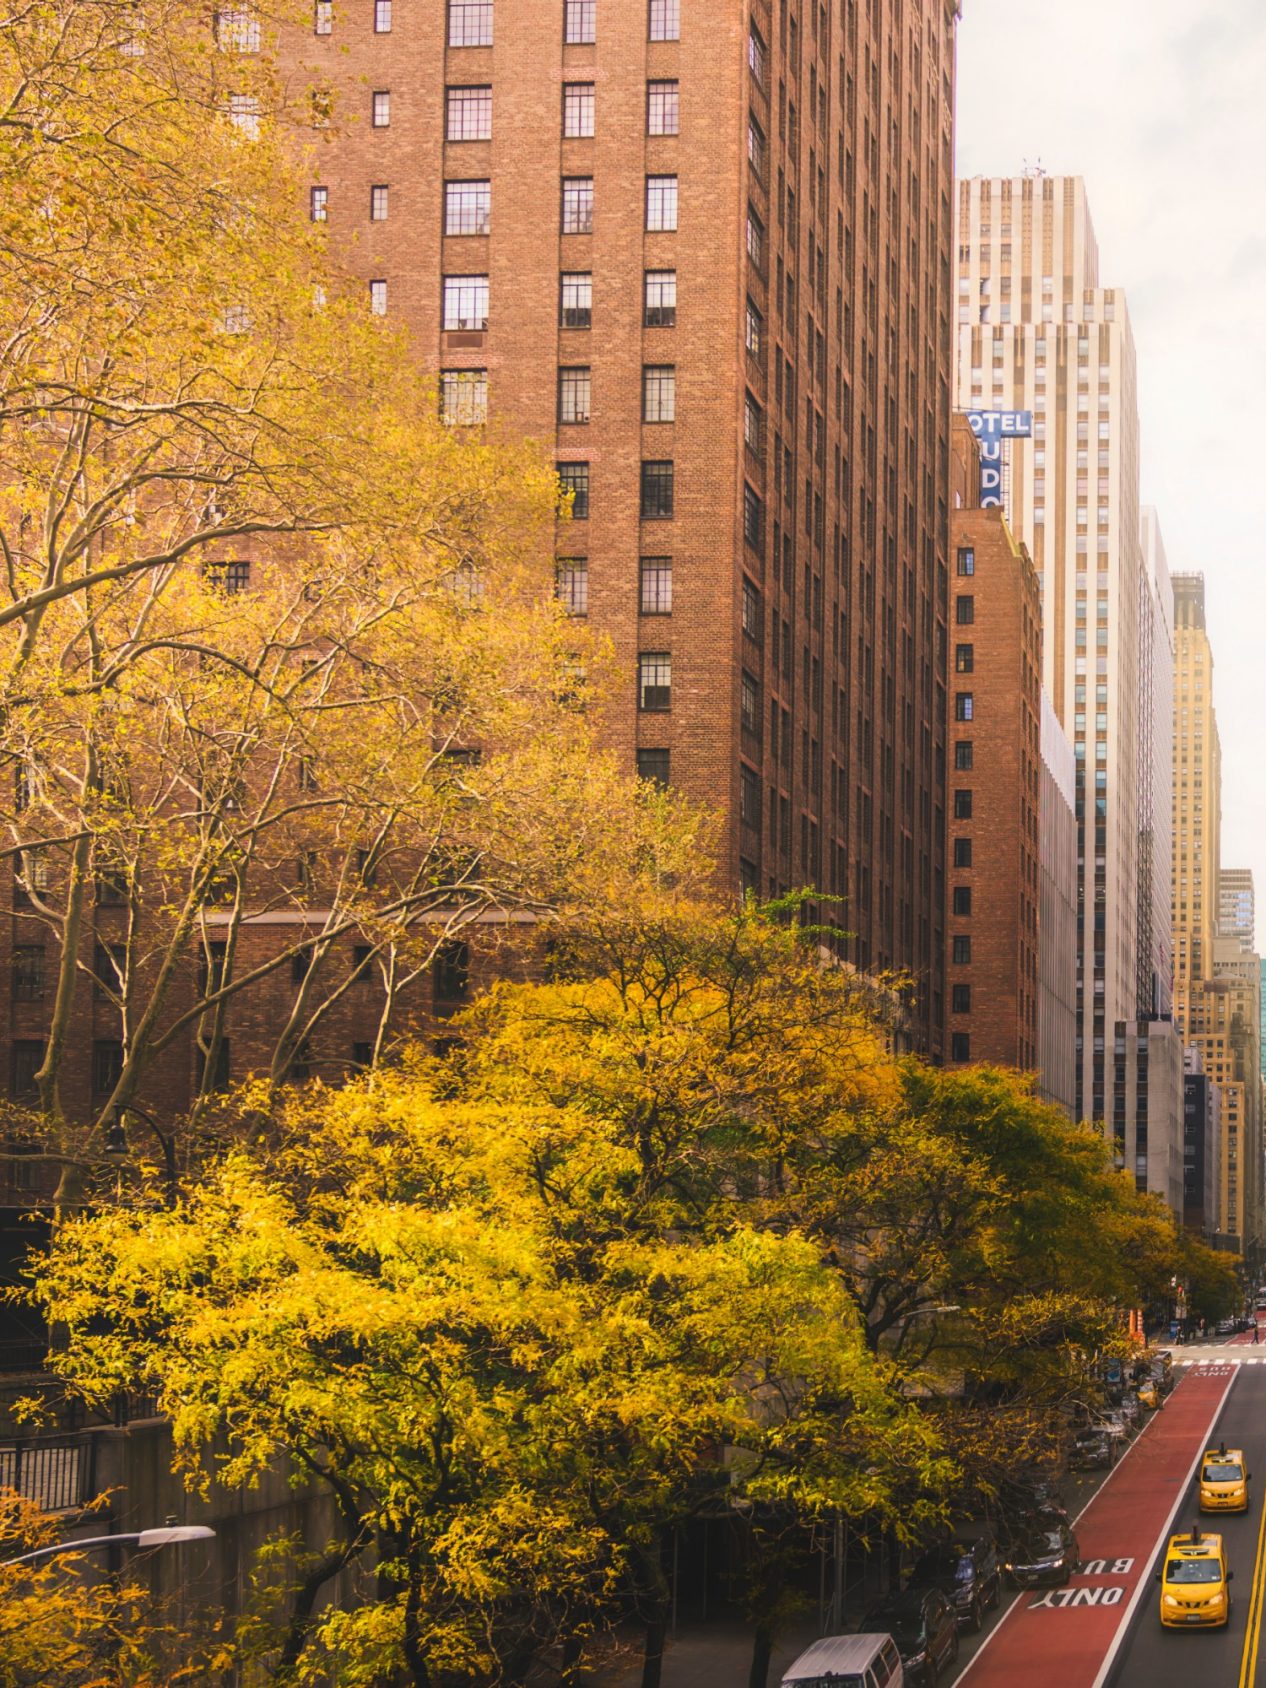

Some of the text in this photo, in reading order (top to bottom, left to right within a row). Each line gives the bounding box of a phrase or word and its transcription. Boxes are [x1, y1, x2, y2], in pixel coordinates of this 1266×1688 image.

[968, 413, 1029, 432] OTEL
[1083, 1558, 1135, 1575] BU
[1027, 1587, 1123, 1609] ONLY
